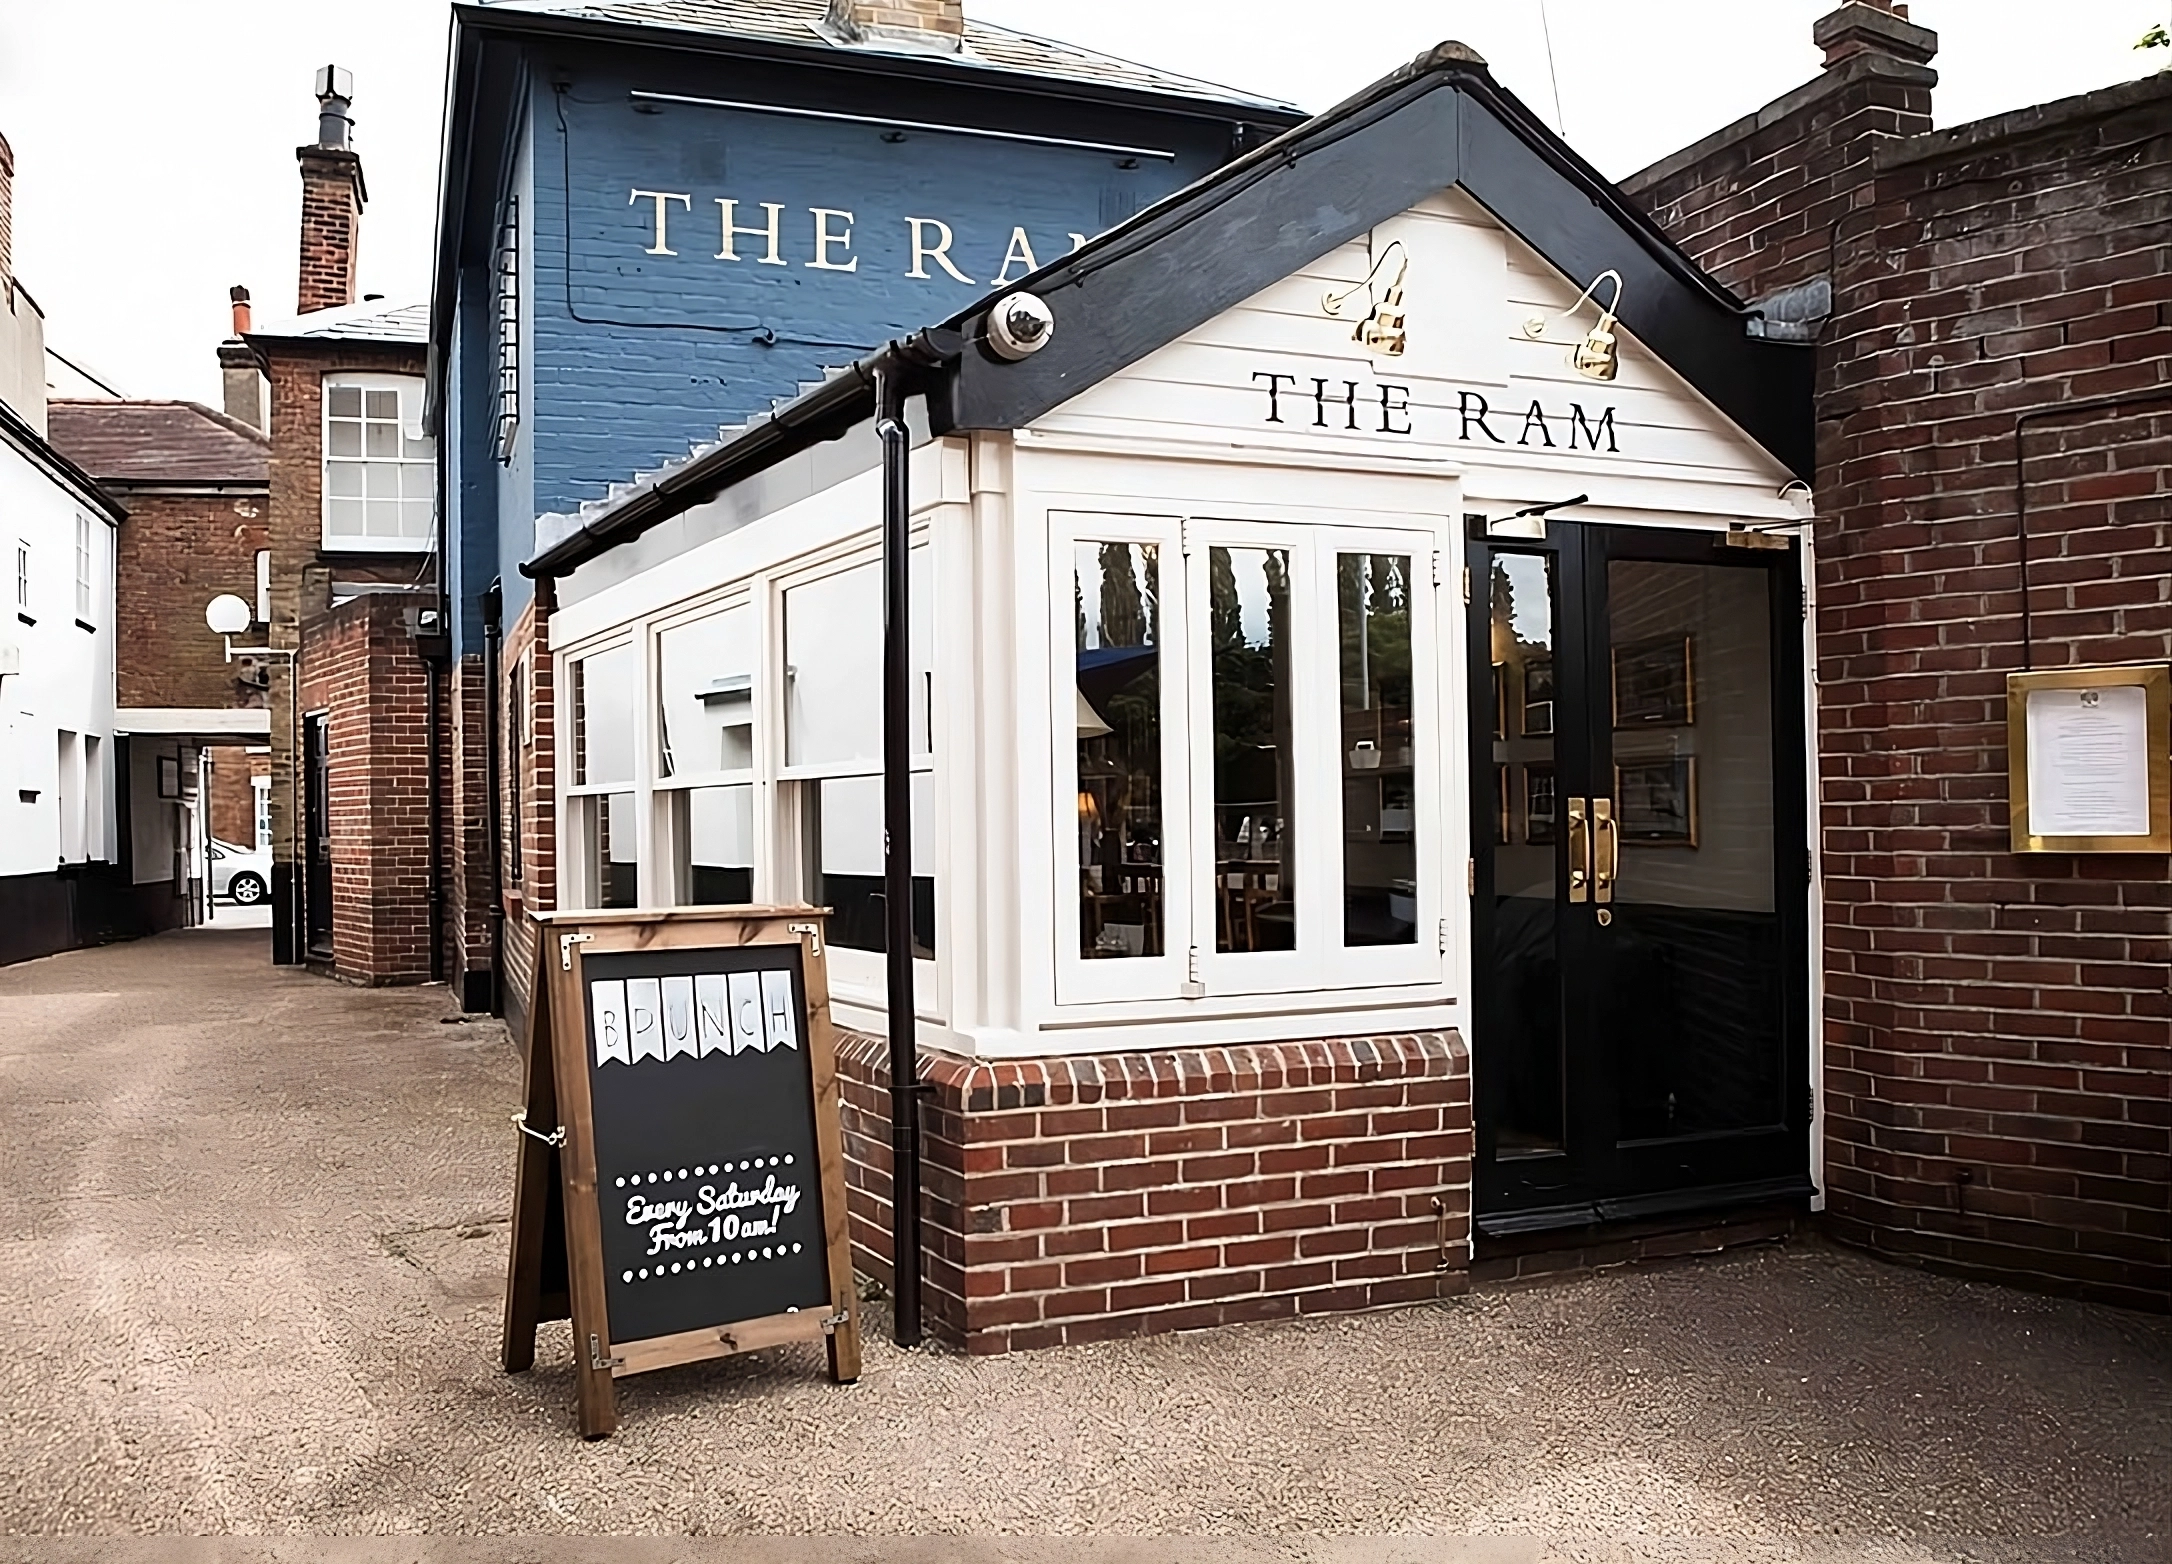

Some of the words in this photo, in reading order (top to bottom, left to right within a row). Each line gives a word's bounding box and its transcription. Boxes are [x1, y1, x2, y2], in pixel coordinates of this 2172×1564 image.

[628, 187, 858, 273] THE
[904, 215, 1088, 286] RA
[1252, 371, 1412, 436] THE
[1457, 389, 1621, 454] RAM
[625, 1195, 693, 1230] Every
[696, 1174, 800, 1215] Saturday
[646, 1221, 708, 1255] From
